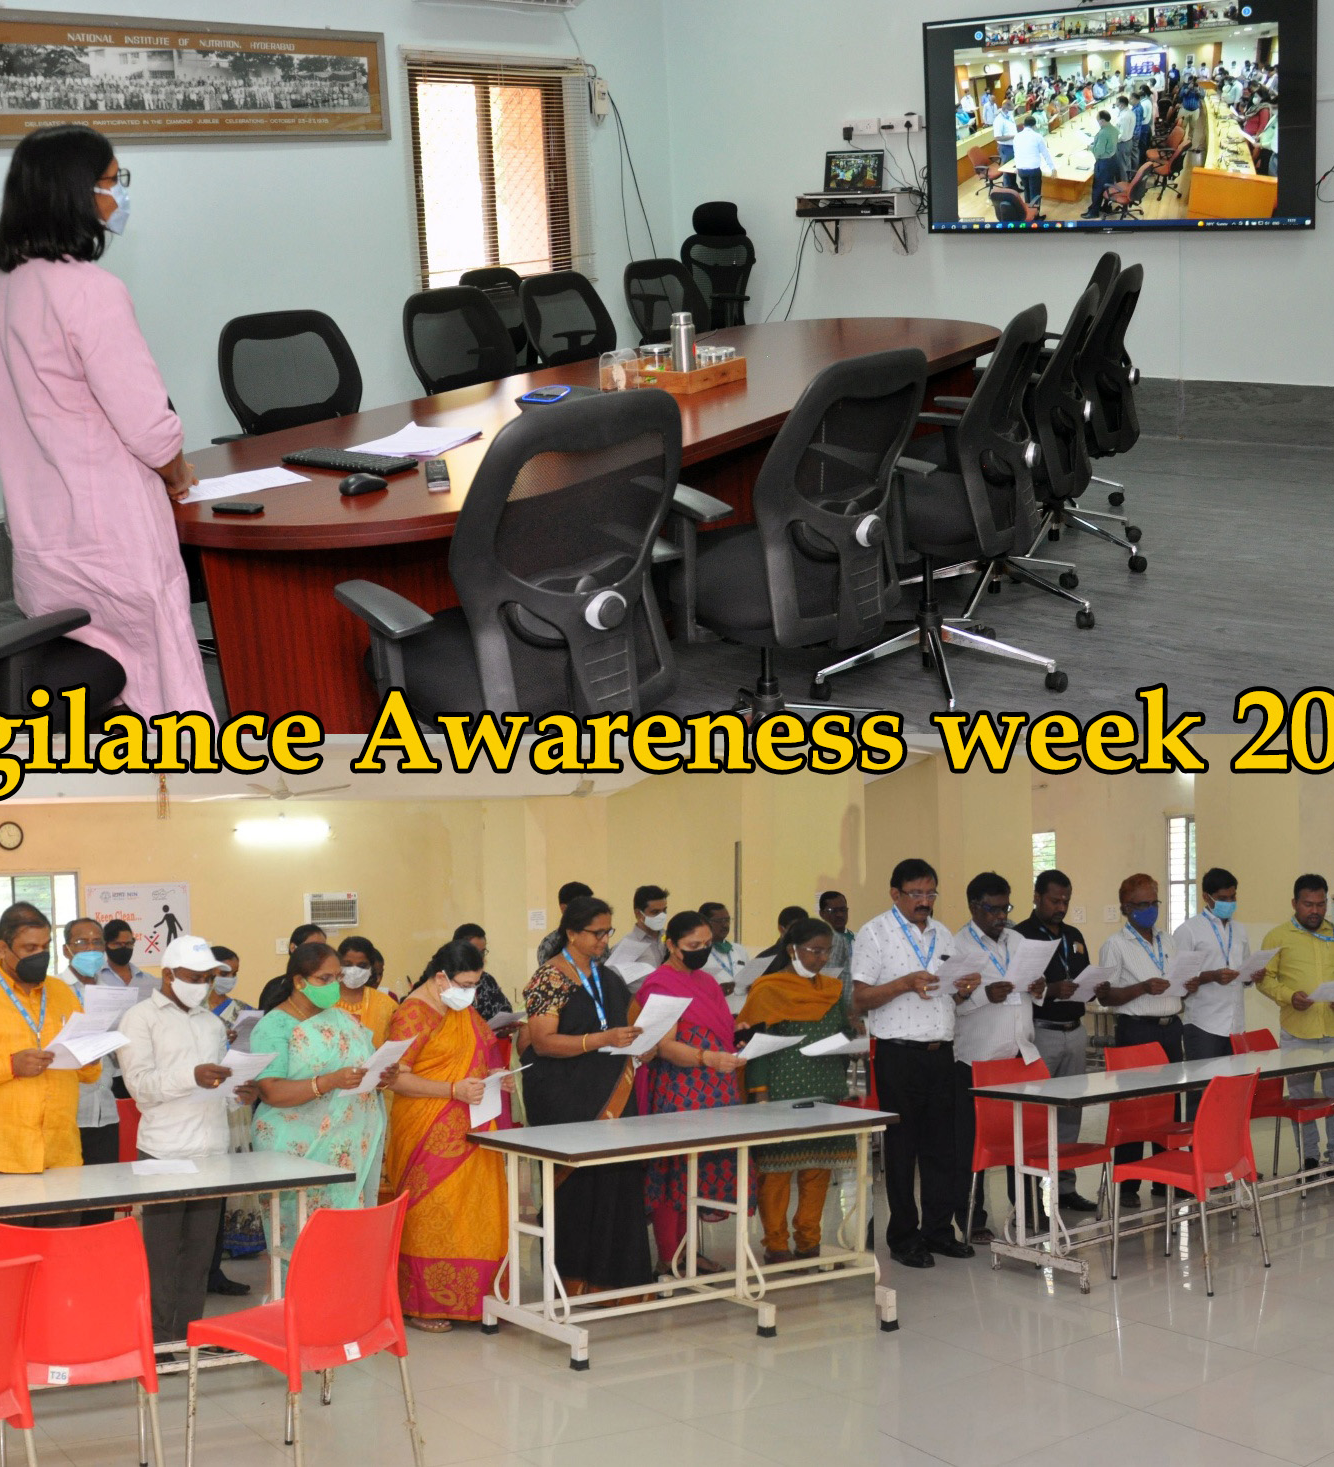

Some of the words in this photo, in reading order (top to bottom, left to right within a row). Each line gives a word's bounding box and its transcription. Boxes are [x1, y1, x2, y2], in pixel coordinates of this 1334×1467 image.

[67, 33, 114, 43] NATIONAL
[124, 35, 170, 46] INSTITUTE
[178, 37, 189, 47] OF
[250, 41, 295, 51] HYDERABAD
